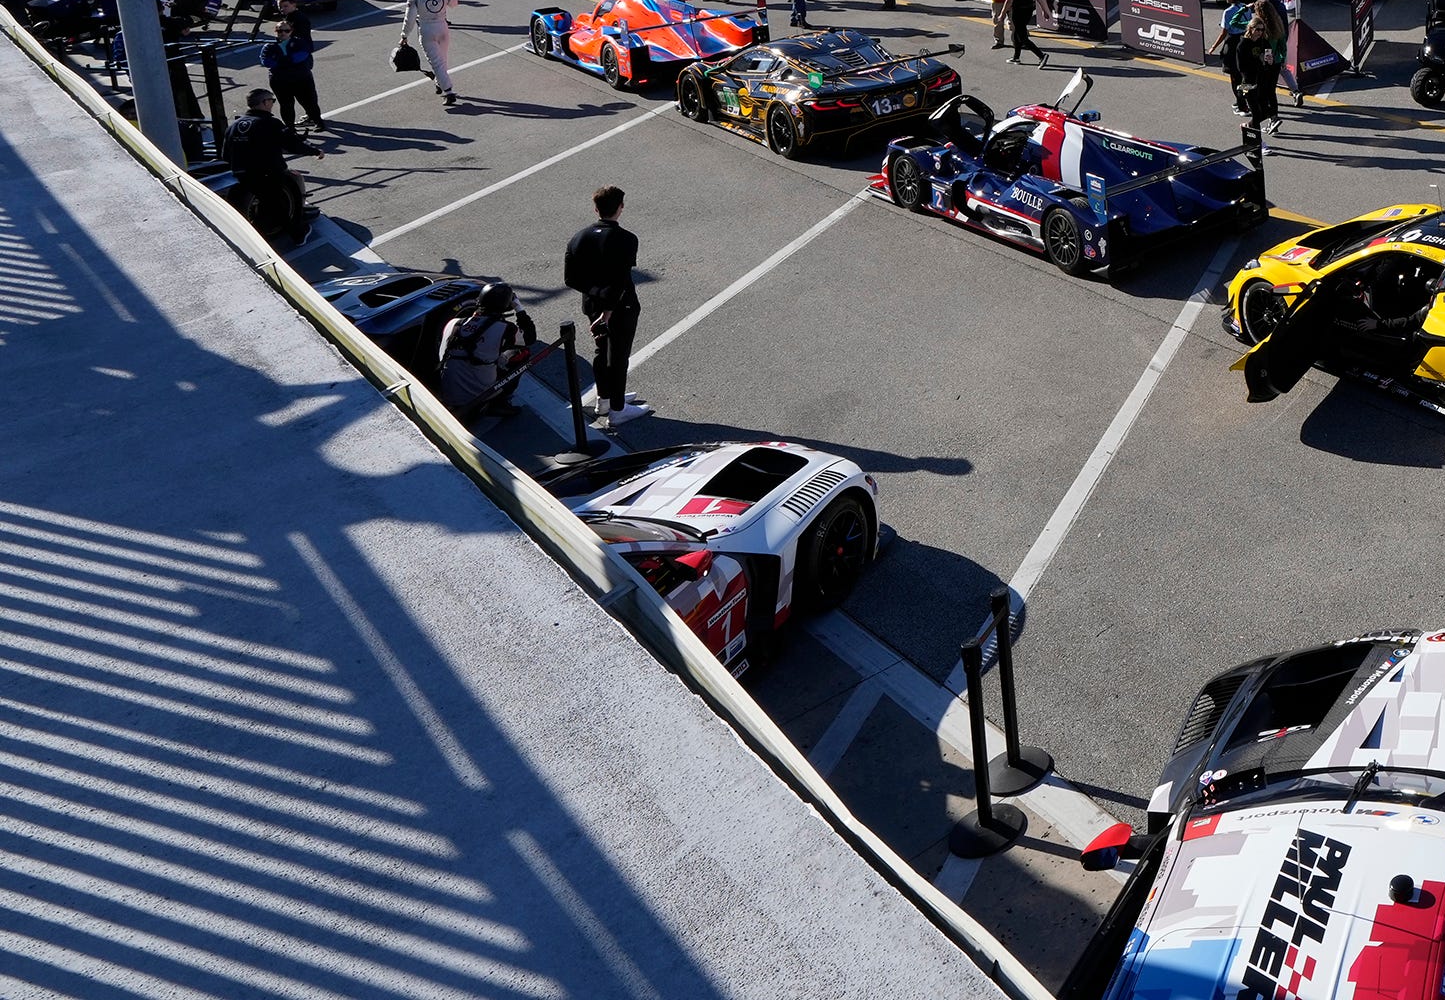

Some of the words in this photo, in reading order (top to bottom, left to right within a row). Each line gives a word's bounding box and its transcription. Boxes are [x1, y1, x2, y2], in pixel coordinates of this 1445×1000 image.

[1137, 23, 1186, 47] JDC
[1139, 41, 1186, 56] MOTORSPORTS
[872, 98, 893, 116] 13
[934, 191, 943, 209] 2
[1012, 186, 1044, 211] BOULLE
[701, 498, 722, 514] 1
[708, 588, 747, 625] WeatherTech
[721, 610, 733, 645] 1
[1346, 669, 1385, 705] Motorsport
[1236, 806, 1346, 821] Motorsport
[1291, 837, 1352, 944] PAUL
